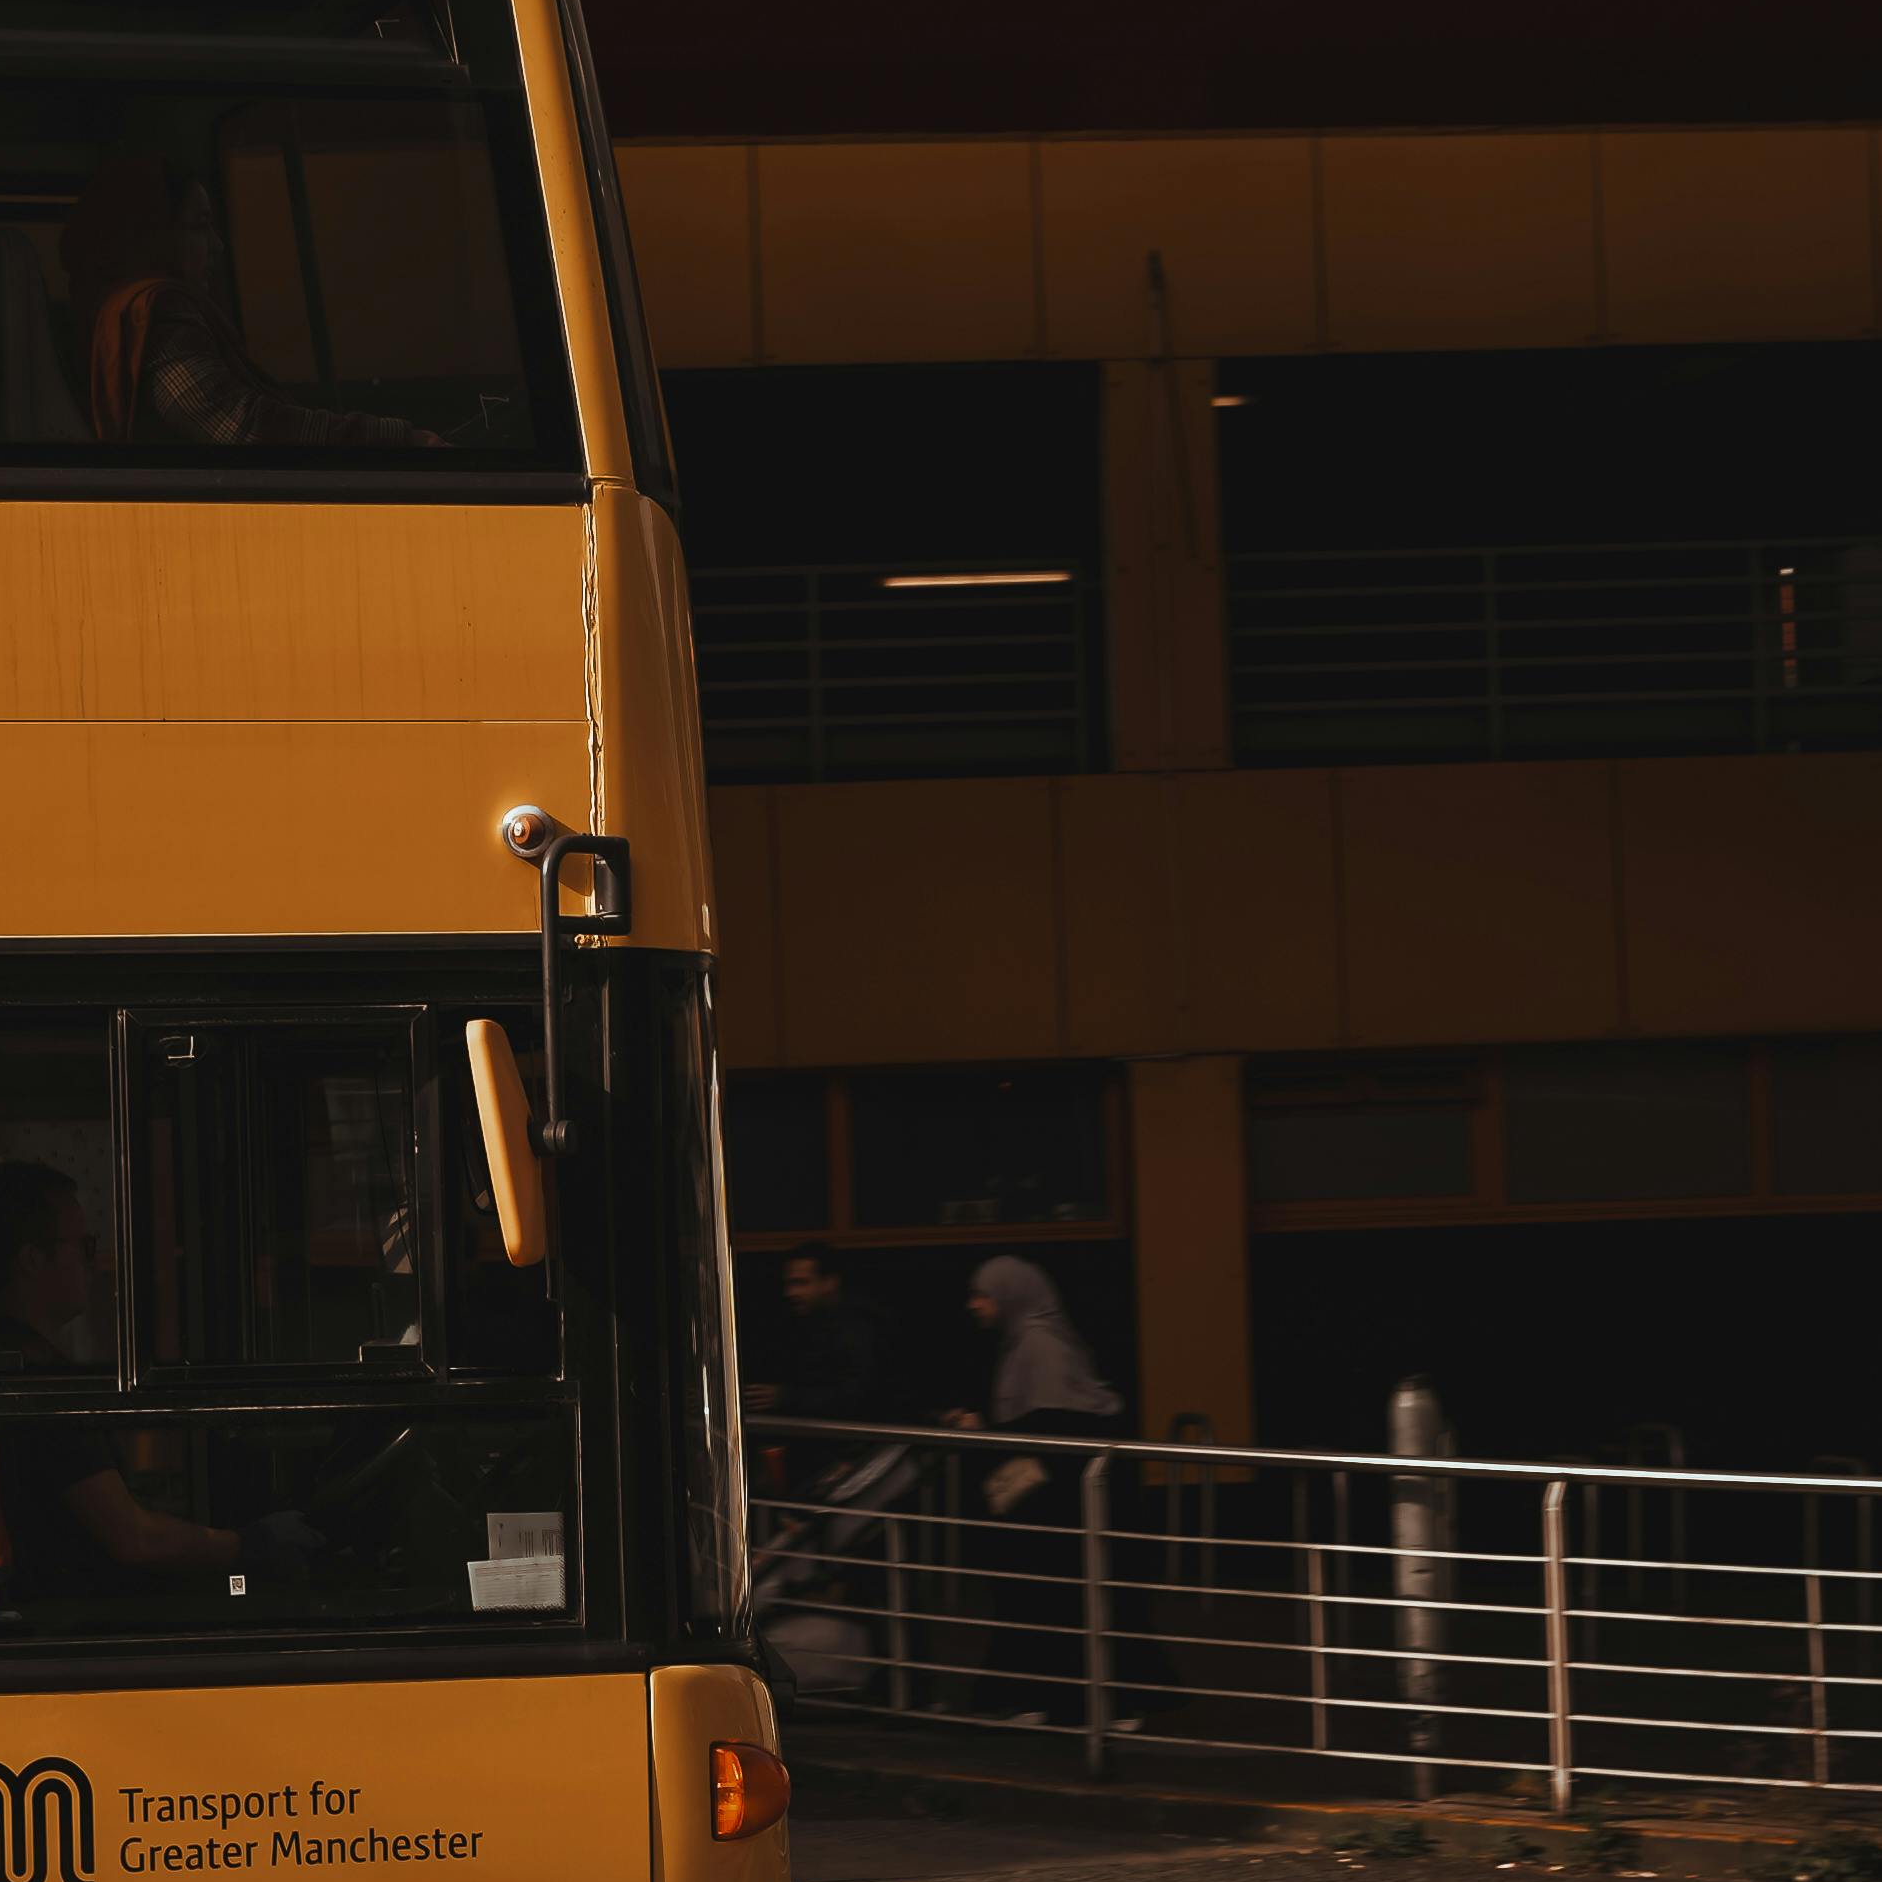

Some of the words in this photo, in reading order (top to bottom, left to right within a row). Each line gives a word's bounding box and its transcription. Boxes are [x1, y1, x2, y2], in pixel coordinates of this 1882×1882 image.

[118, 1784, 299, 1831] Transport
[308, 1780, 362, 1816] for
[119, 1835, 260, 1873] Greater
[270, 1826, 484, 1867] Manchester
